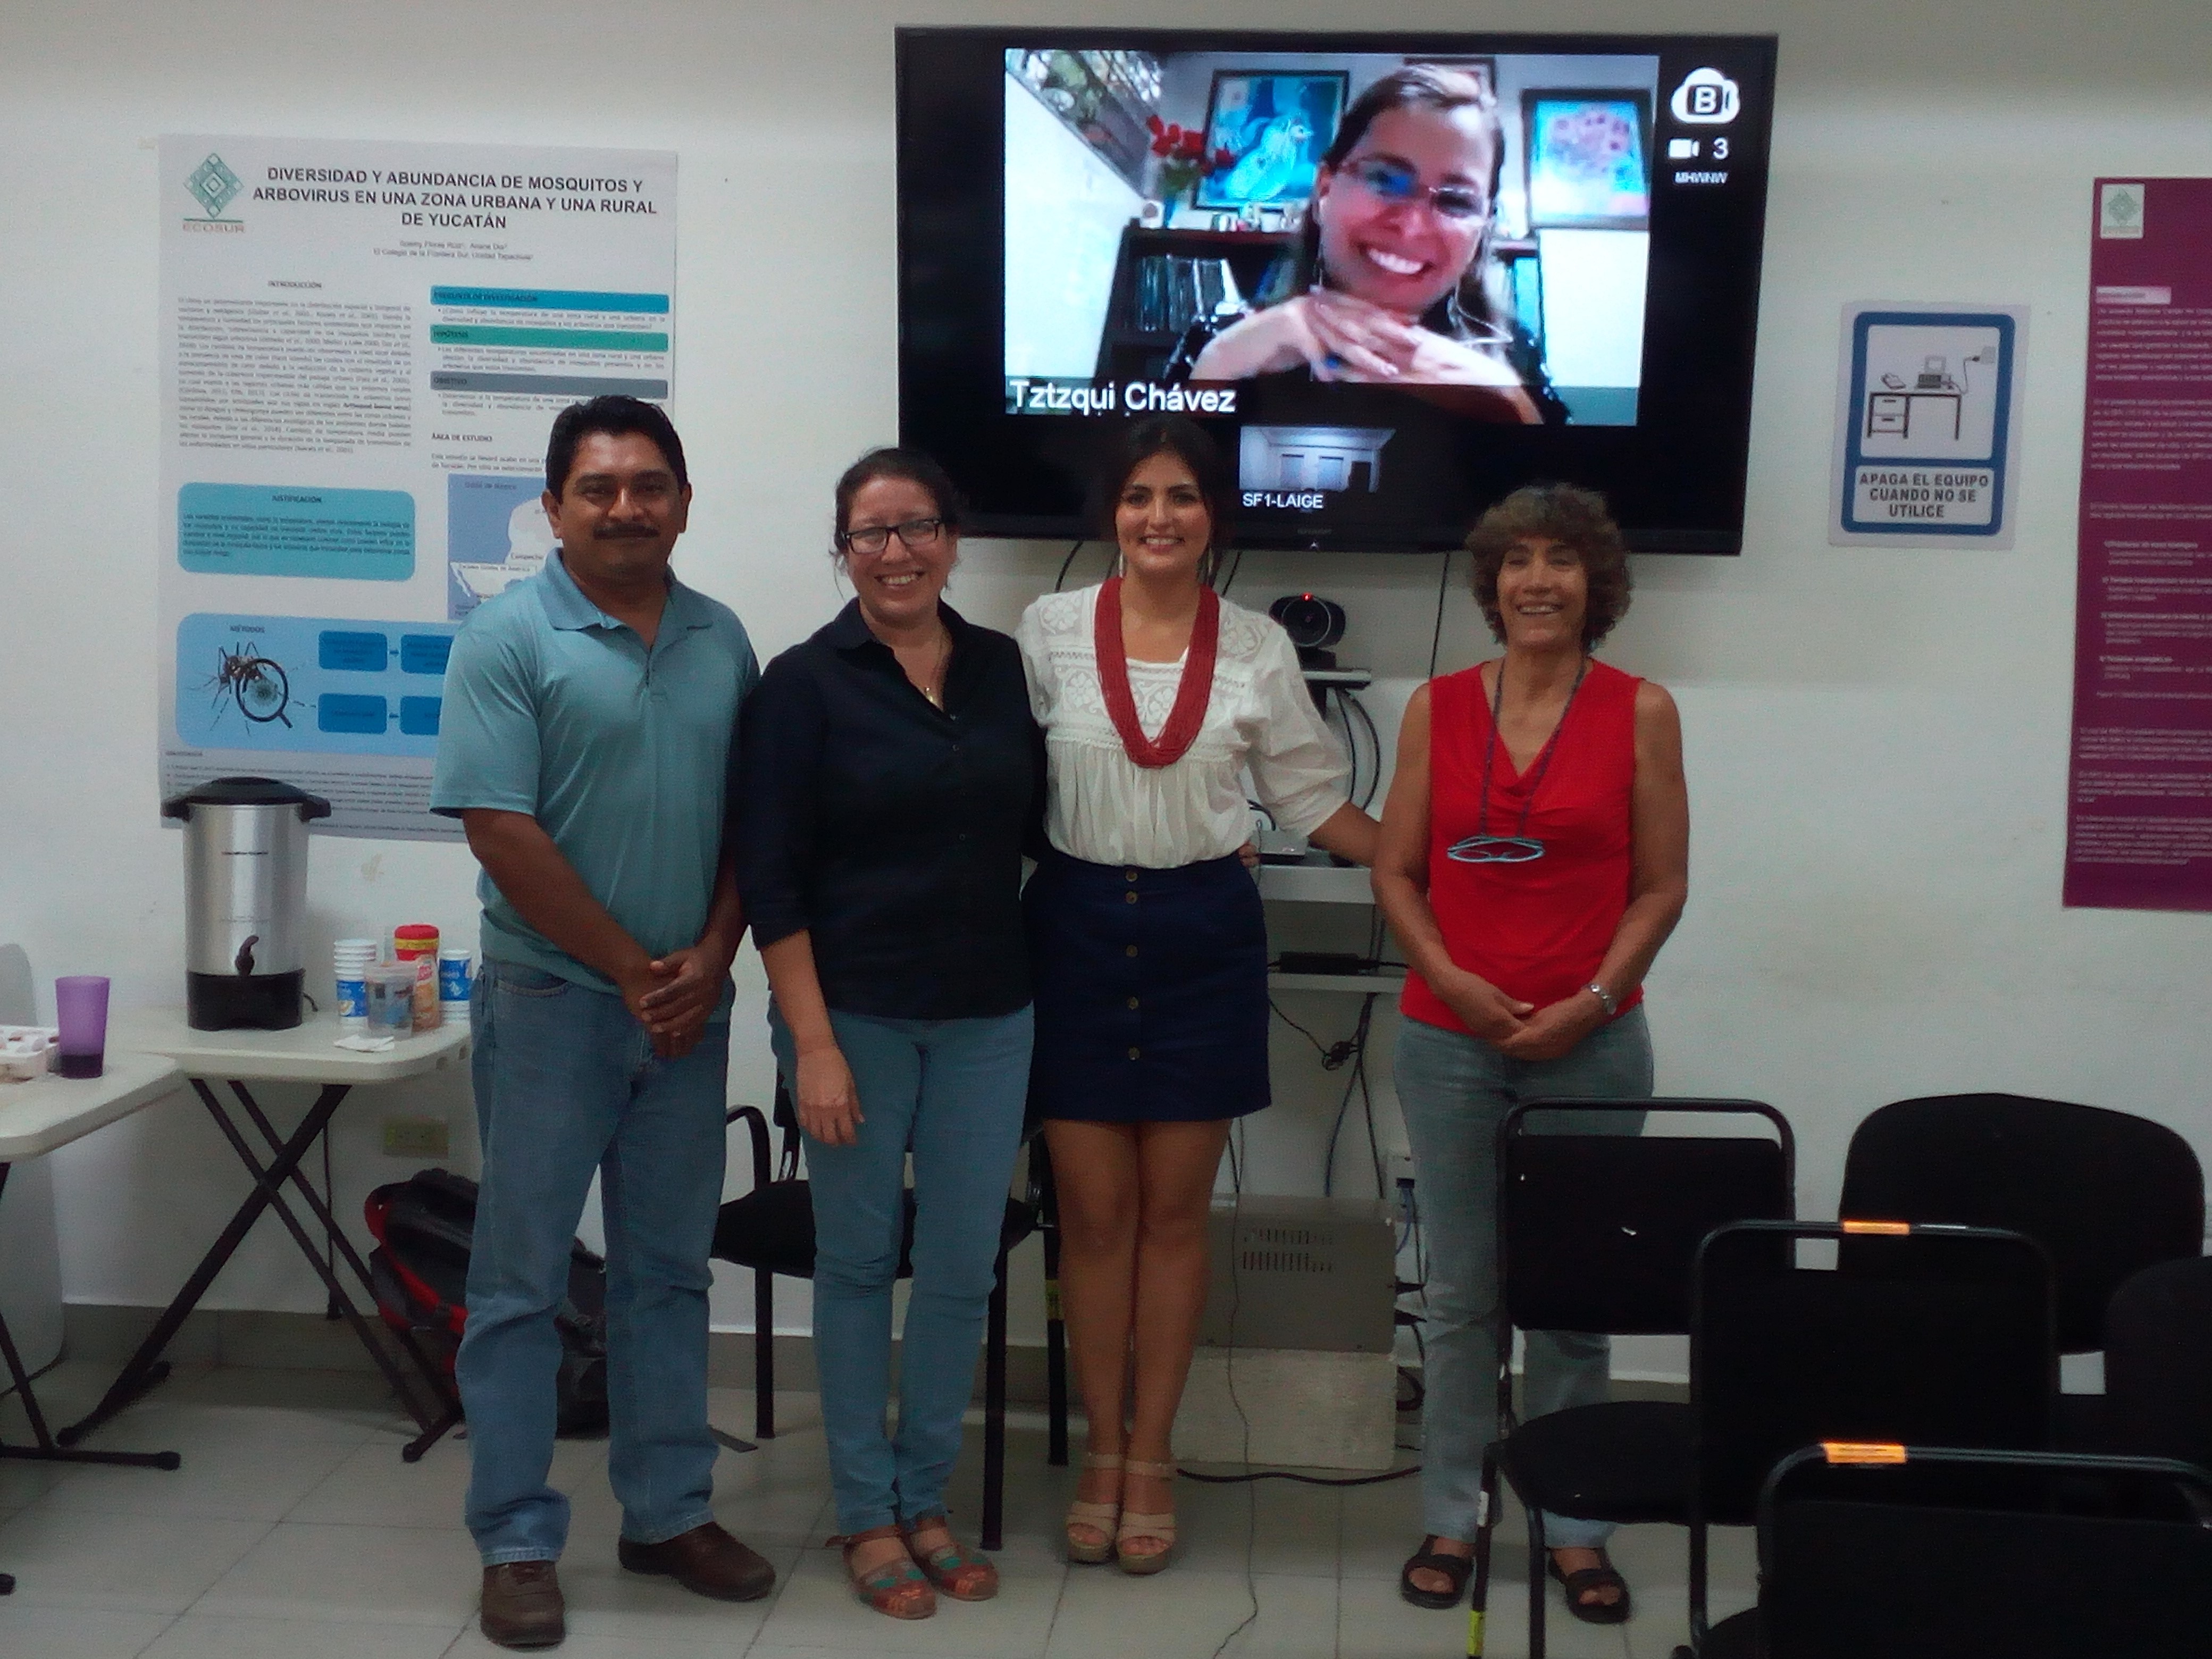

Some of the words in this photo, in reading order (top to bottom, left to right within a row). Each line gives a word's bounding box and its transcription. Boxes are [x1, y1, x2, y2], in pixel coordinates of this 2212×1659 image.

[1713, 137, 1728, 160] 3
[267, 167, 366, 183] DIVERSIDAD
[372, 171, 382, 184] Y
[387, 172, 496, 188] ABUNDANCIA
[501, 175, 523, 188] DE
[529, 176, 627, 192] MOSQUITOS
[632, 180, 643, 192] Y
[253, 187, 349, 203] ARBOVIRUS
[355, 190, 375, 204] EN
[382, 191, 416, 206] UNA
[421, 193, 466, 207] ZONA
[472, 195, 542, 210] URBANA
[545, 197, 556, 211] Y
[561, 197, 596, 212] UNA
[601, 199, 657, 214] RURAL
[182, 223, 245, 233] ECOSUR
[402, 213, 423, 225] DE
[429, 212, 506, 229] YUCATÁN
[1009, 380, 1116, 417] Tztzqui
[1125, 383, 1236, 413] Chávez
[1859, 473, 1908, 486] APAGA
[1913, 473, 1930, 486] EL
[1934, 474, 1989, 488] EQUIPO
[1242, 493, 1323, 509] SF1-LAIGE
[1869, 488, 1930, 501] CUANDO
[1934, 489, 1955, 502] NO
[1958, 489, 1977, 502] SE
[1889, 504, 1945, 518] UTILICE
